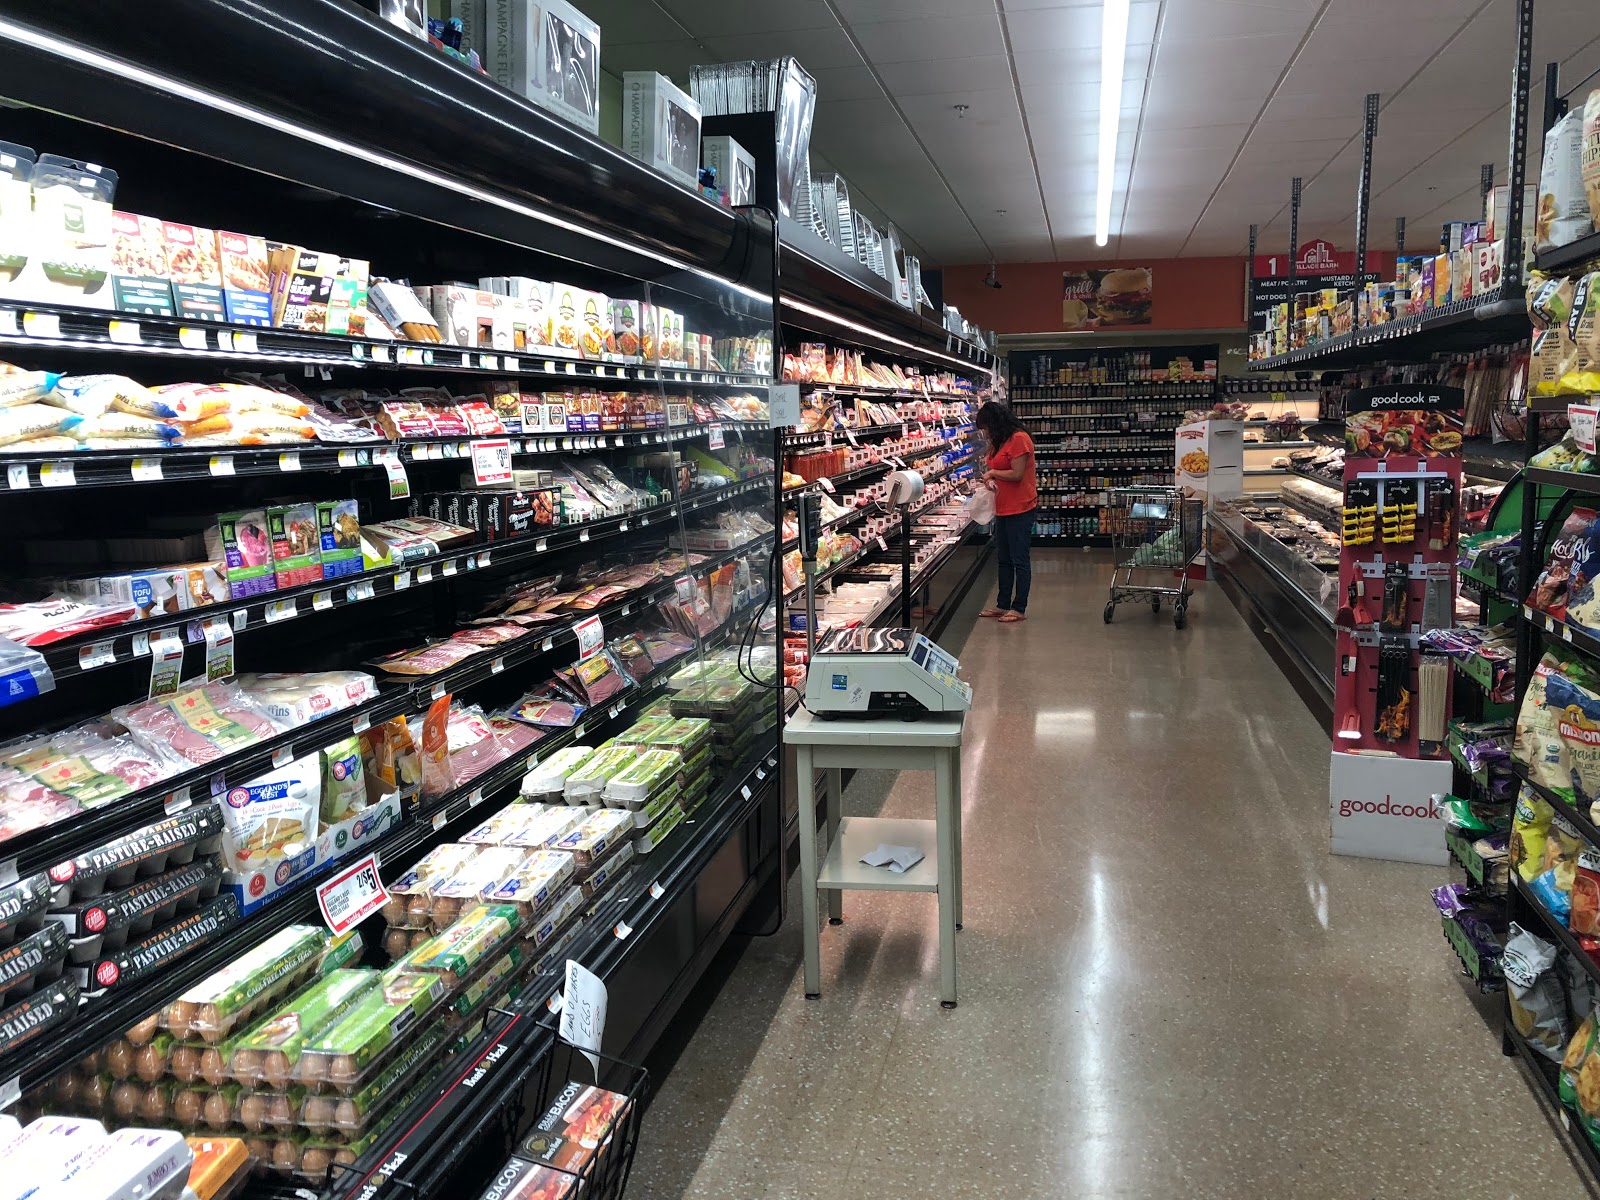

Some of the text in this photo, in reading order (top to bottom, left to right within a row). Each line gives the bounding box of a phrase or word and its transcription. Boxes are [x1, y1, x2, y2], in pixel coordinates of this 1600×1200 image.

[631, 82, 640, 138] CHAMPAGNE
[1269, 258, 1277, 275] 1
[1065, 280, 1094, 300] grill
[134, 589, 151, 597] TOFU
[297, 710, 304, 720] 6
[250, 783, 288, 795] EGGLAND'S
[261, 791, 279, 800] BEST
[1339, 795, 1440, 820] goodcook
[128, 866, 188, 897] VITAL FARMS
[255, 877, 260, 886] 6
[140, 915, 201, 949] VITAL FARMS
[279, 957, 298, 977] LARGE
[298, 949, 312, 963] EGGS
[580, 1000, 591, 1038] EGGS
[463, 1043, 508, 1088] Boar's Head
[551, 1081, 581, 1116] BACON
[379, 1152, 408, 1177] Head
[486, 1160, 524, 1200] BACON
